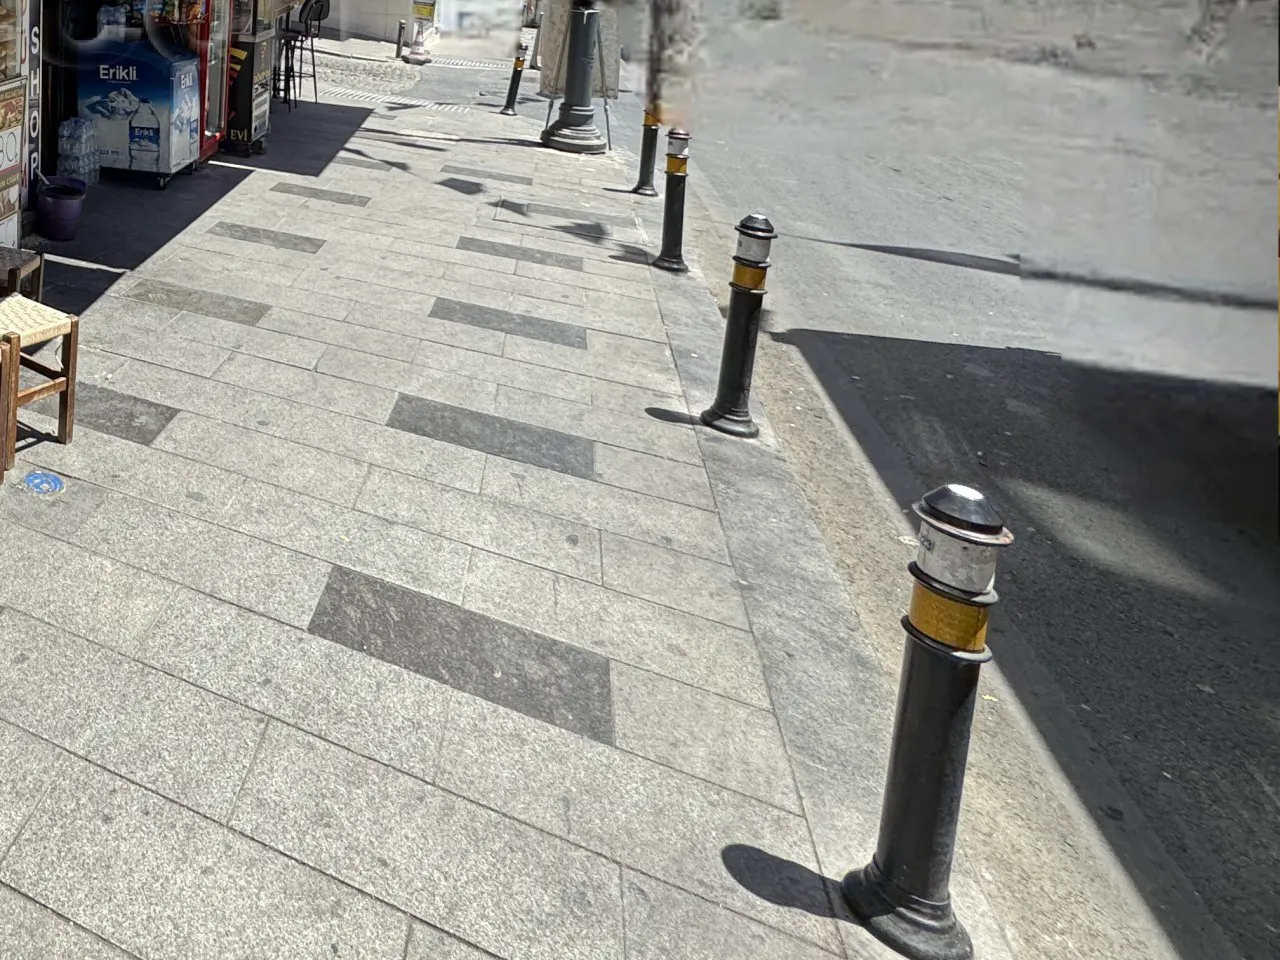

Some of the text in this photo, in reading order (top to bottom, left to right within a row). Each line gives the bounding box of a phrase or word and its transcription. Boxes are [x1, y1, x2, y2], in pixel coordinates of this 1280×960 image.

[99, 64, 137, 81] Erikli
[31, 26, 41, 181] SHOP
[134, 127, 155, 137] Erikli
